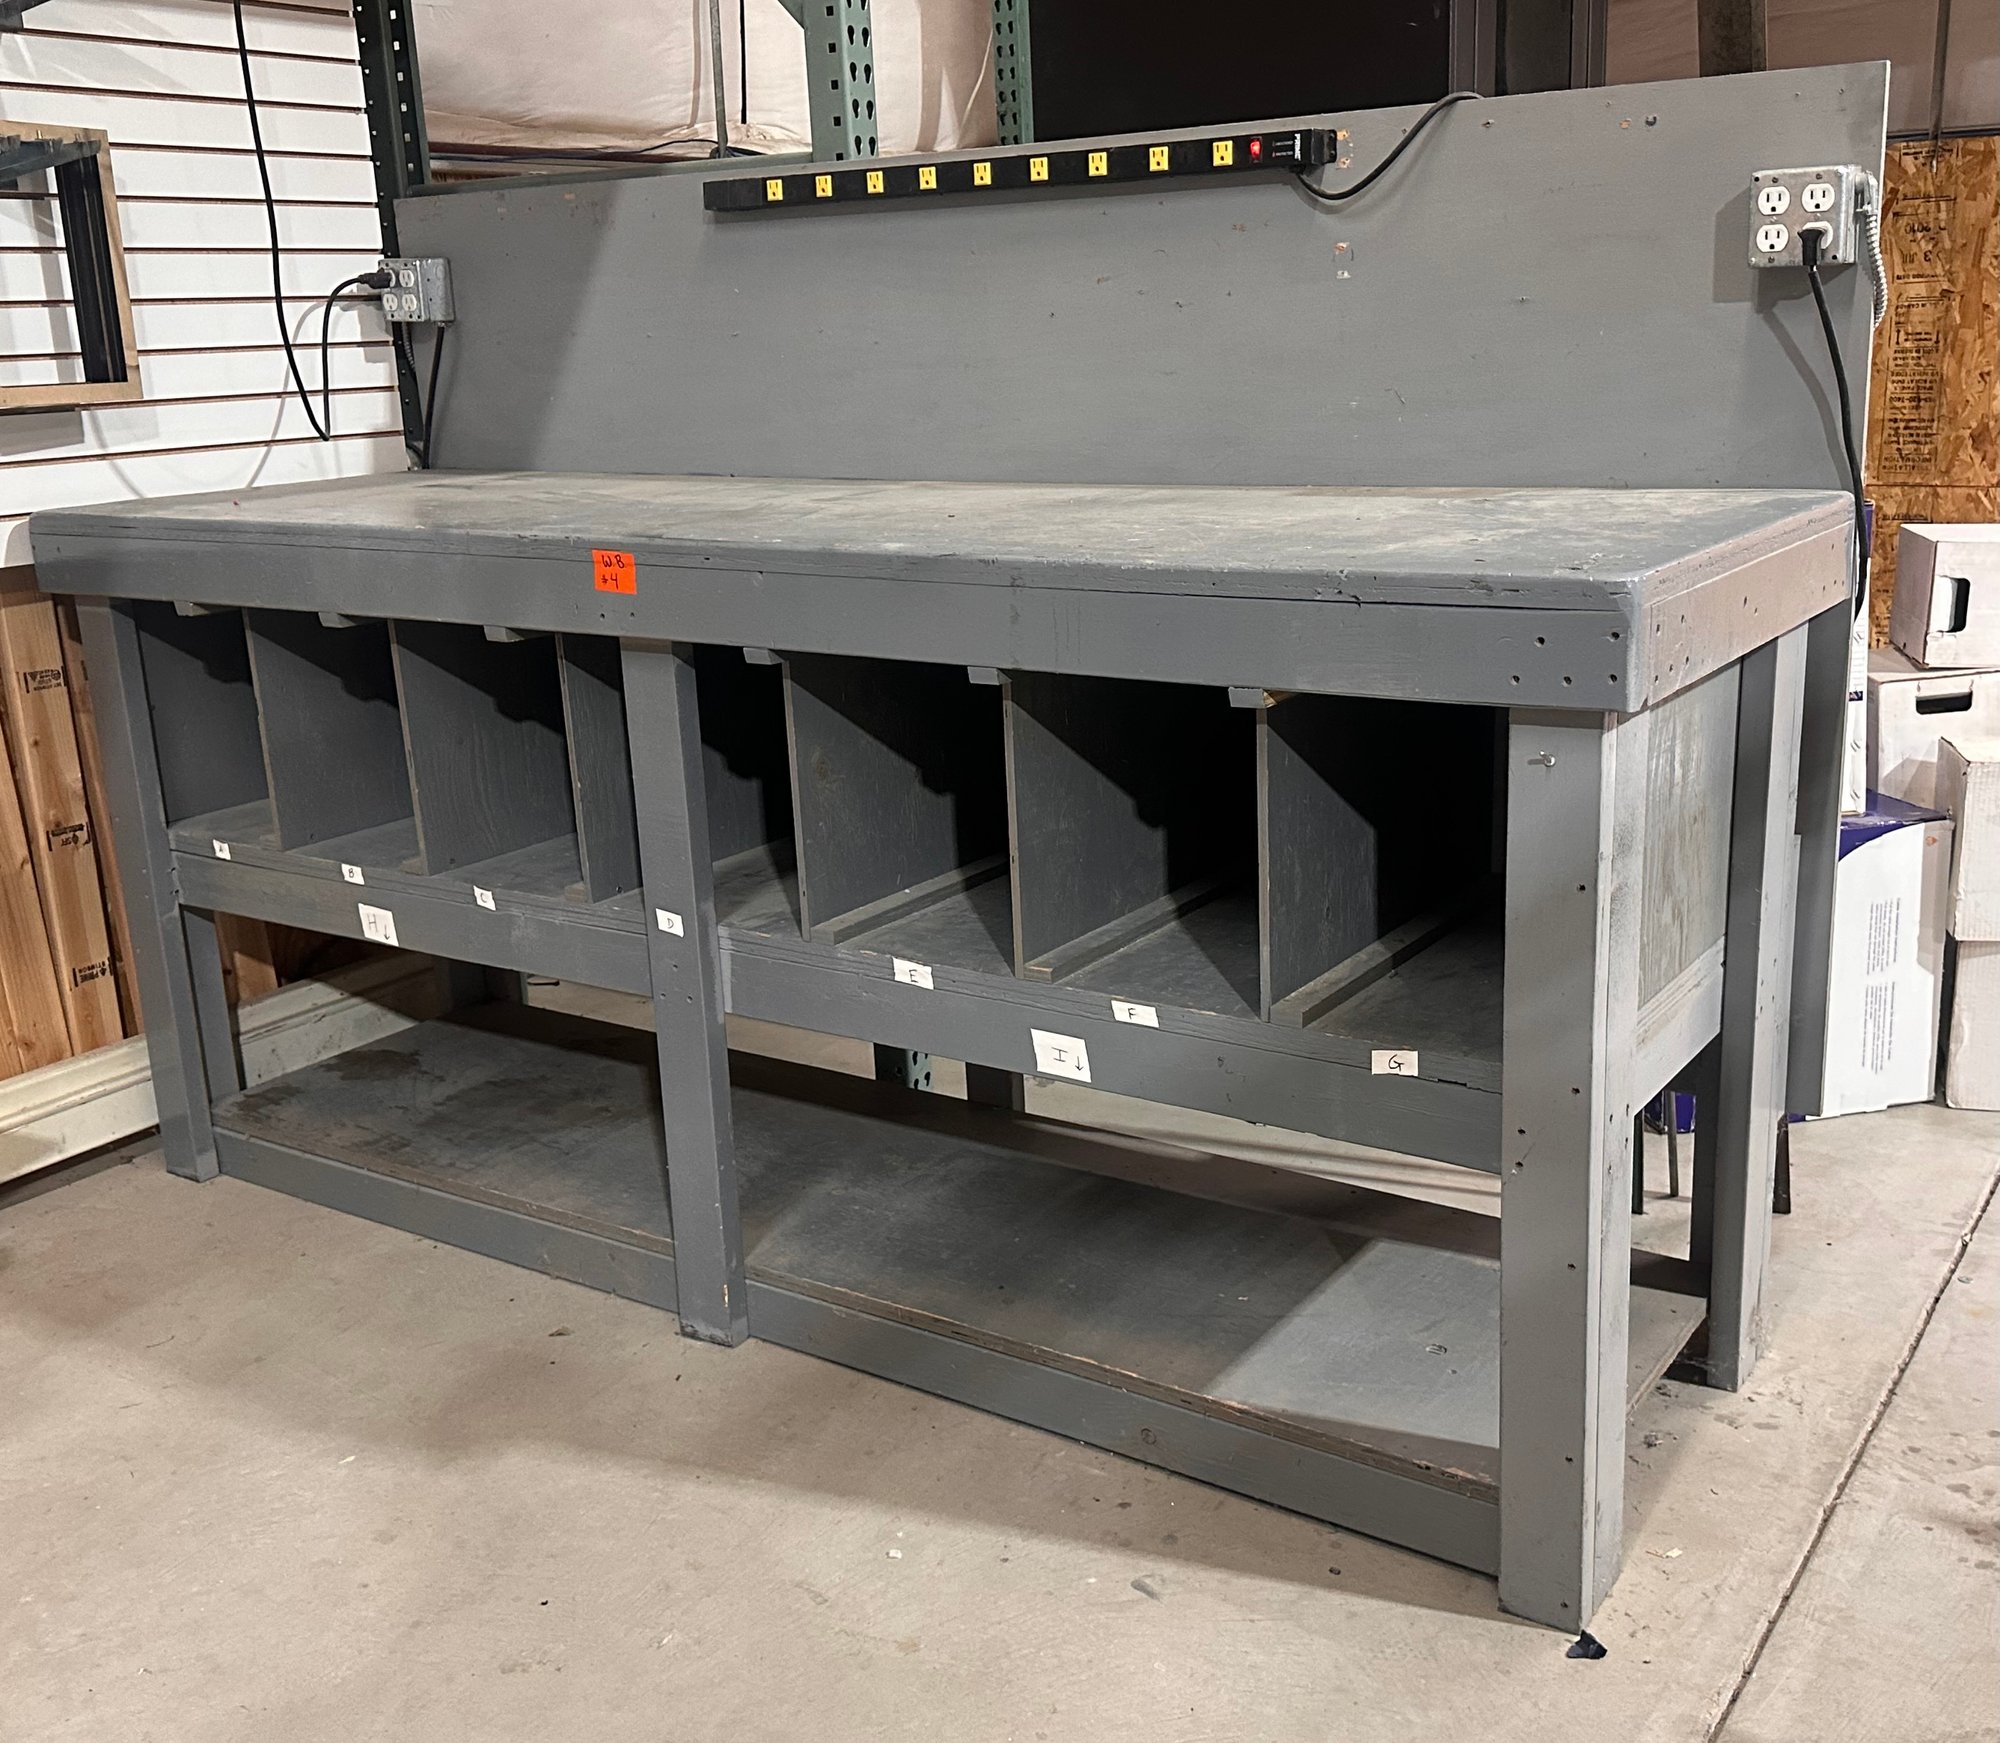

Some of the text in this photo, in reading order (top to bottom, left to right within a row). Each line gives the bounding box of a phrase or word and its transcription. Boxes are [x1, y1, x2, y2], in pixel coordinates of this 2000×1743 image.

[348, 867, 354, 879] B
[480, 892, 487, 904] C
[366, 913, 379, 933] H
[667, 917, 674, 929] D
[908, 968, 919, 984] E
[1128, 1007, 1137, 1020] F
[1388, 1053, 1405, 1072] G
